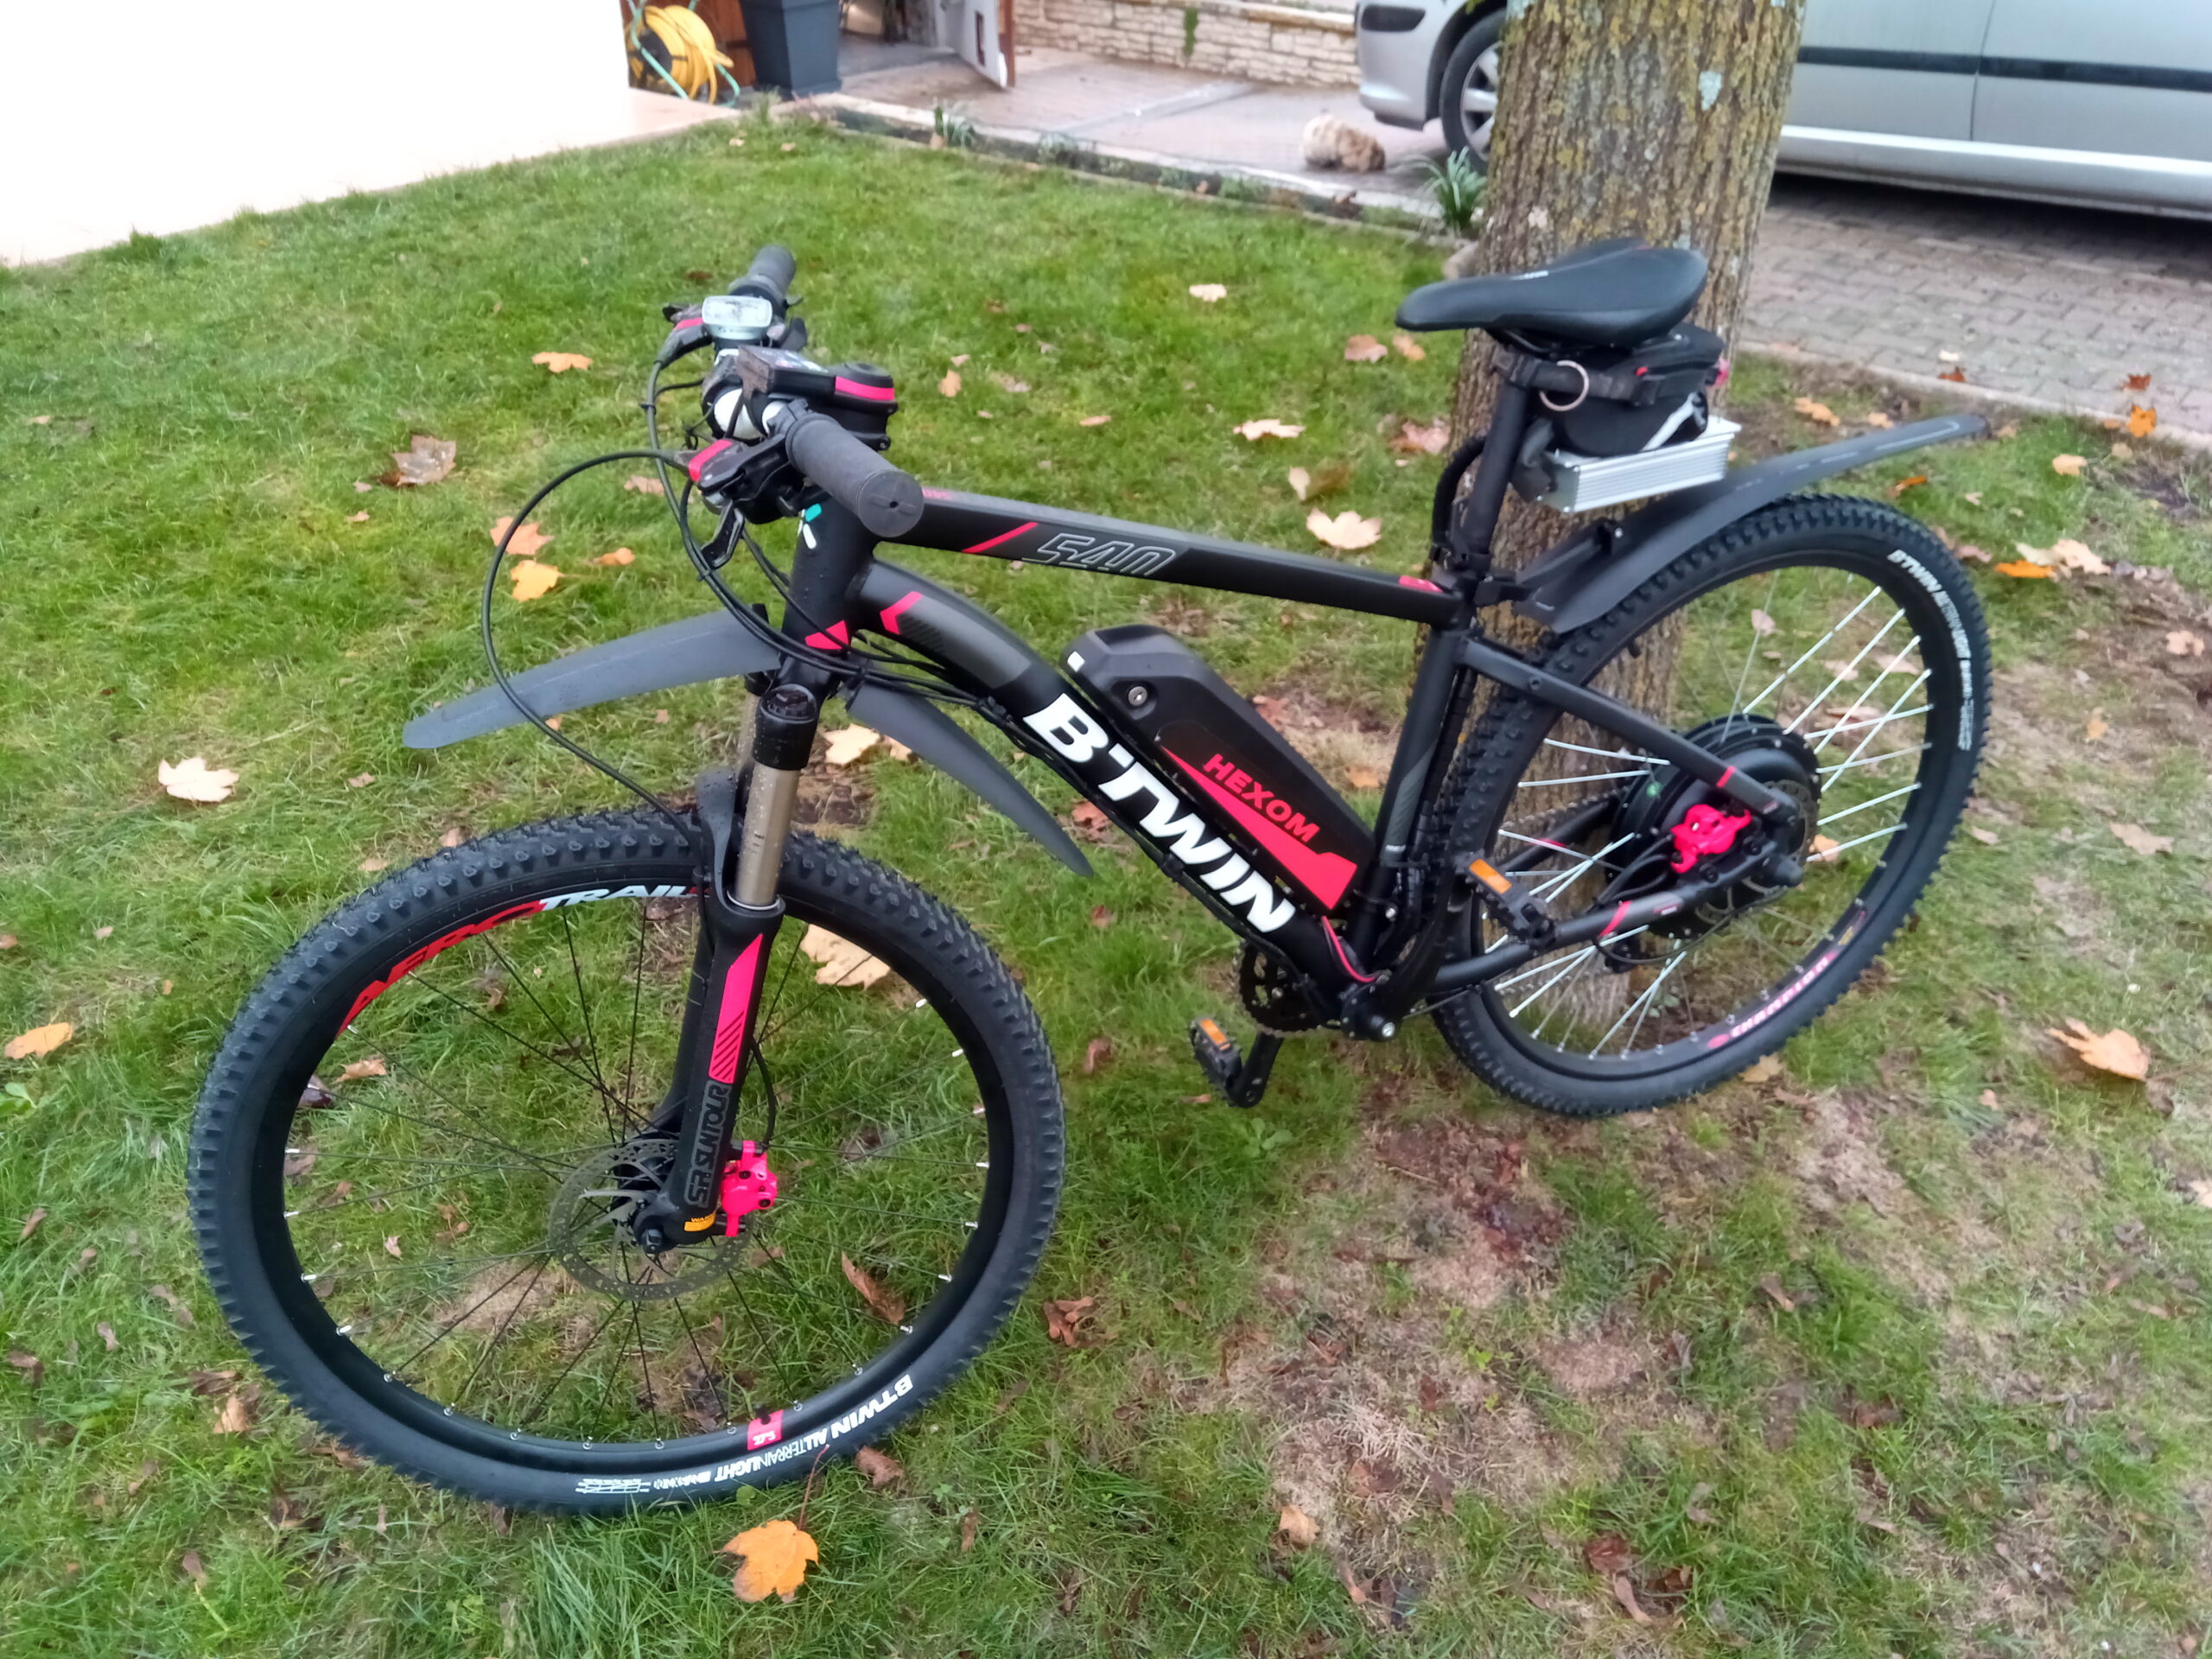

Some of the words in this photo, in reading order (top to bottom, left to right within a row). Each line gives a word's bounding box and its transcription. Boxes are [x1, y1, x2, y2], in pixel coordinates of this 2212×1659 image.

[1021, 532, 1177, 576] 540
[1203, 753, 1320, 842] HEXOM
[695, 1084, 728, 1170] SUNTOUR
